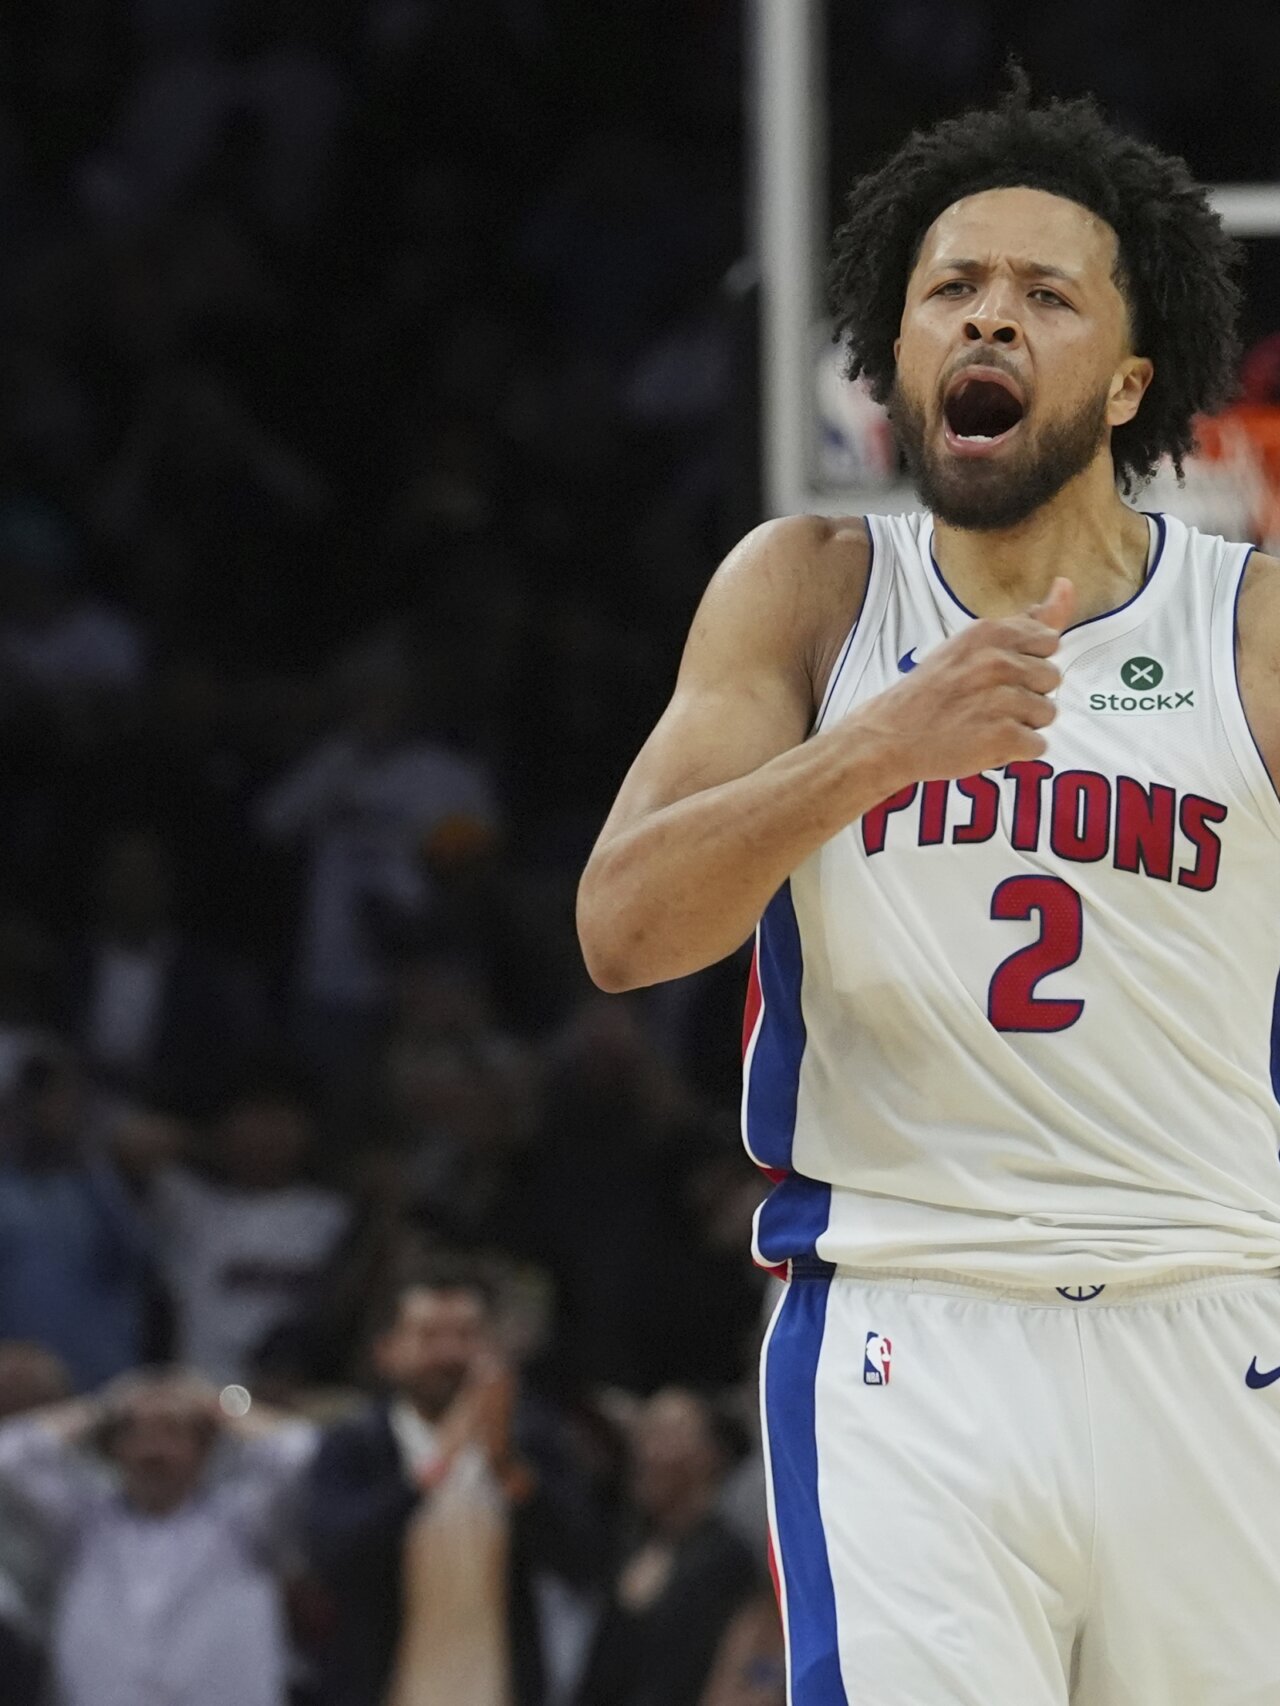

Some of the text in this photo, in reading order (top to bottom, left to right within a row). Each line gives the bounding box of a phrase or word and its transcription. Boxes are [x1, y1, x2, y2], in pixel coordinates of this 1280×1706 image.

[1089, 690, 1194, 711] StockX
[861, 759, 1228, 892] PISTONS
[987, 874, 1085, 1033] 2
